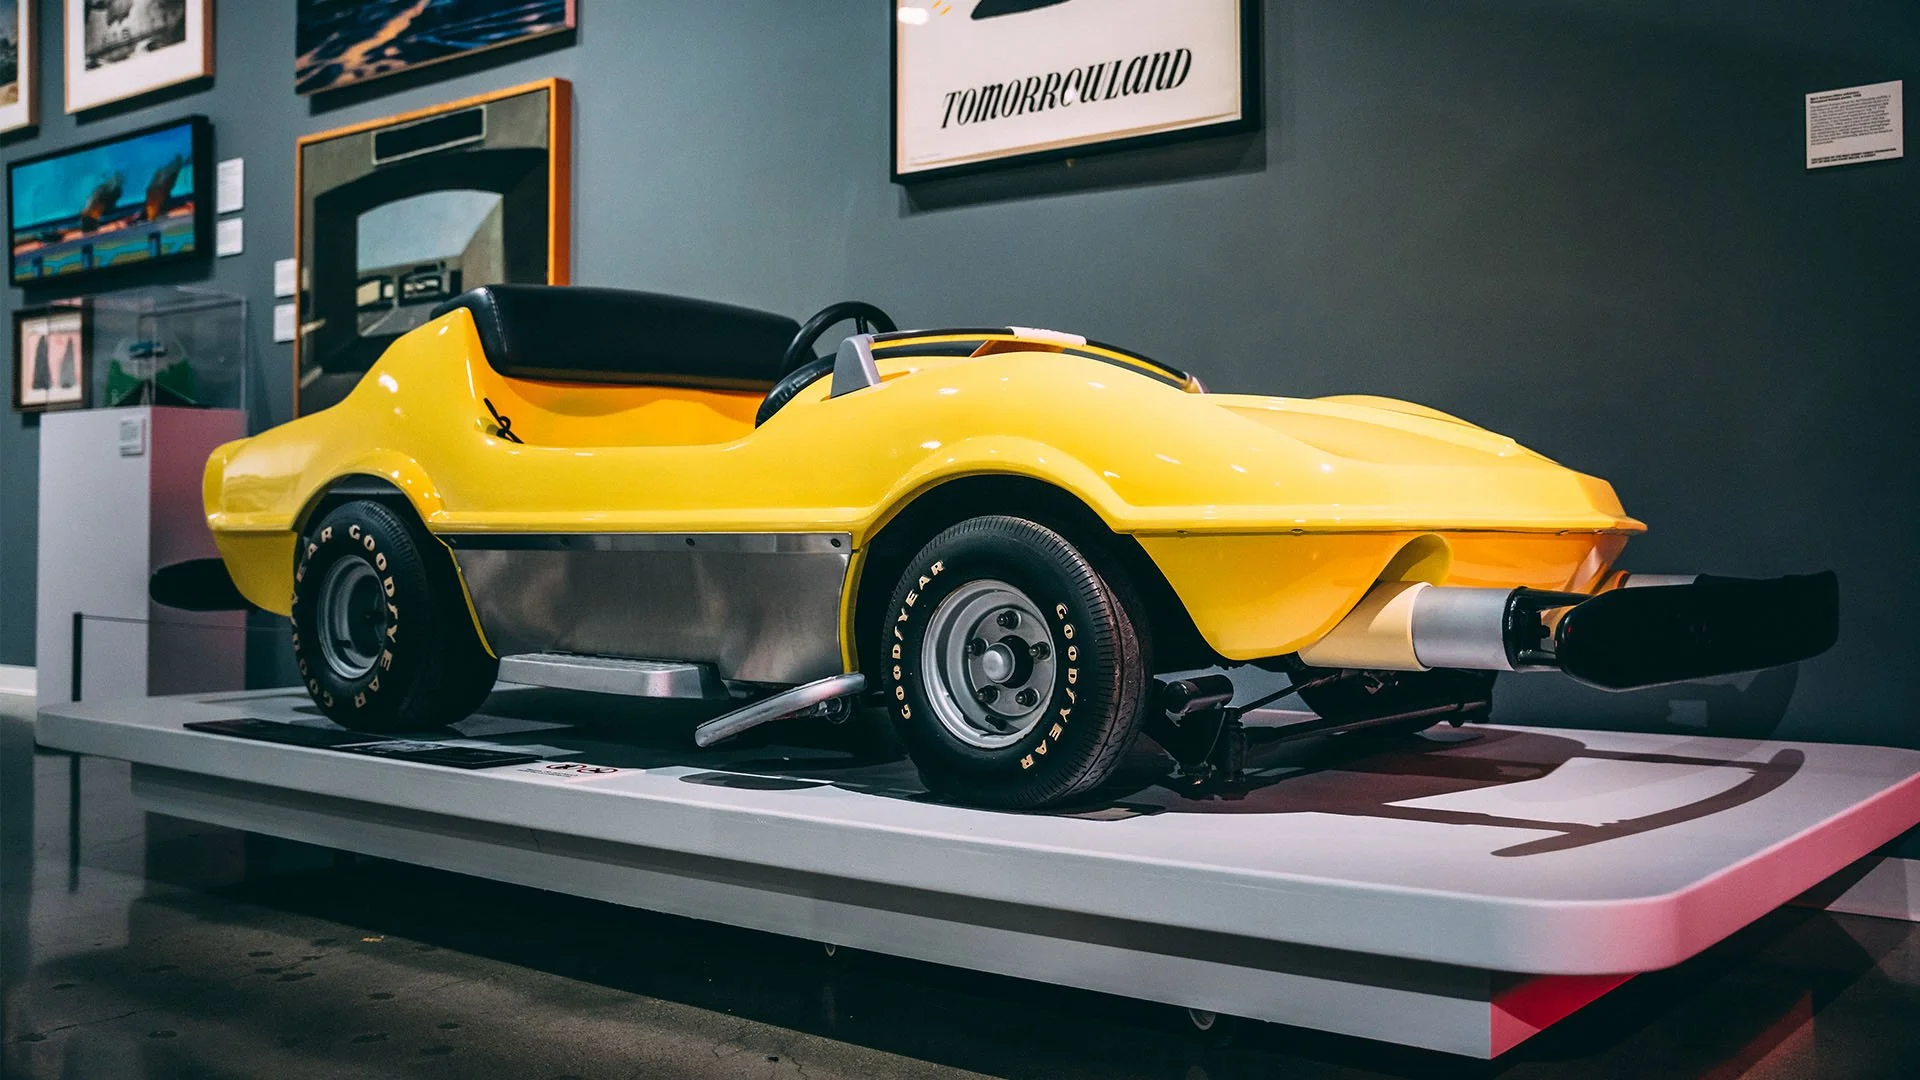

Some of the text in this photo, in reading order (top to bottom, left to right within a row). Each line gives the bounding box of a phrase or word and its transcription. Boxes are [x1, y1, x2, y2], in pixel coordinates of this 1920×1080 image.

[349, 524, 398, 708] GOODYEAR
[893, 560, 944, 719] GOODYEAR
[1021, 603, 1078, 769] GOODYEAR
